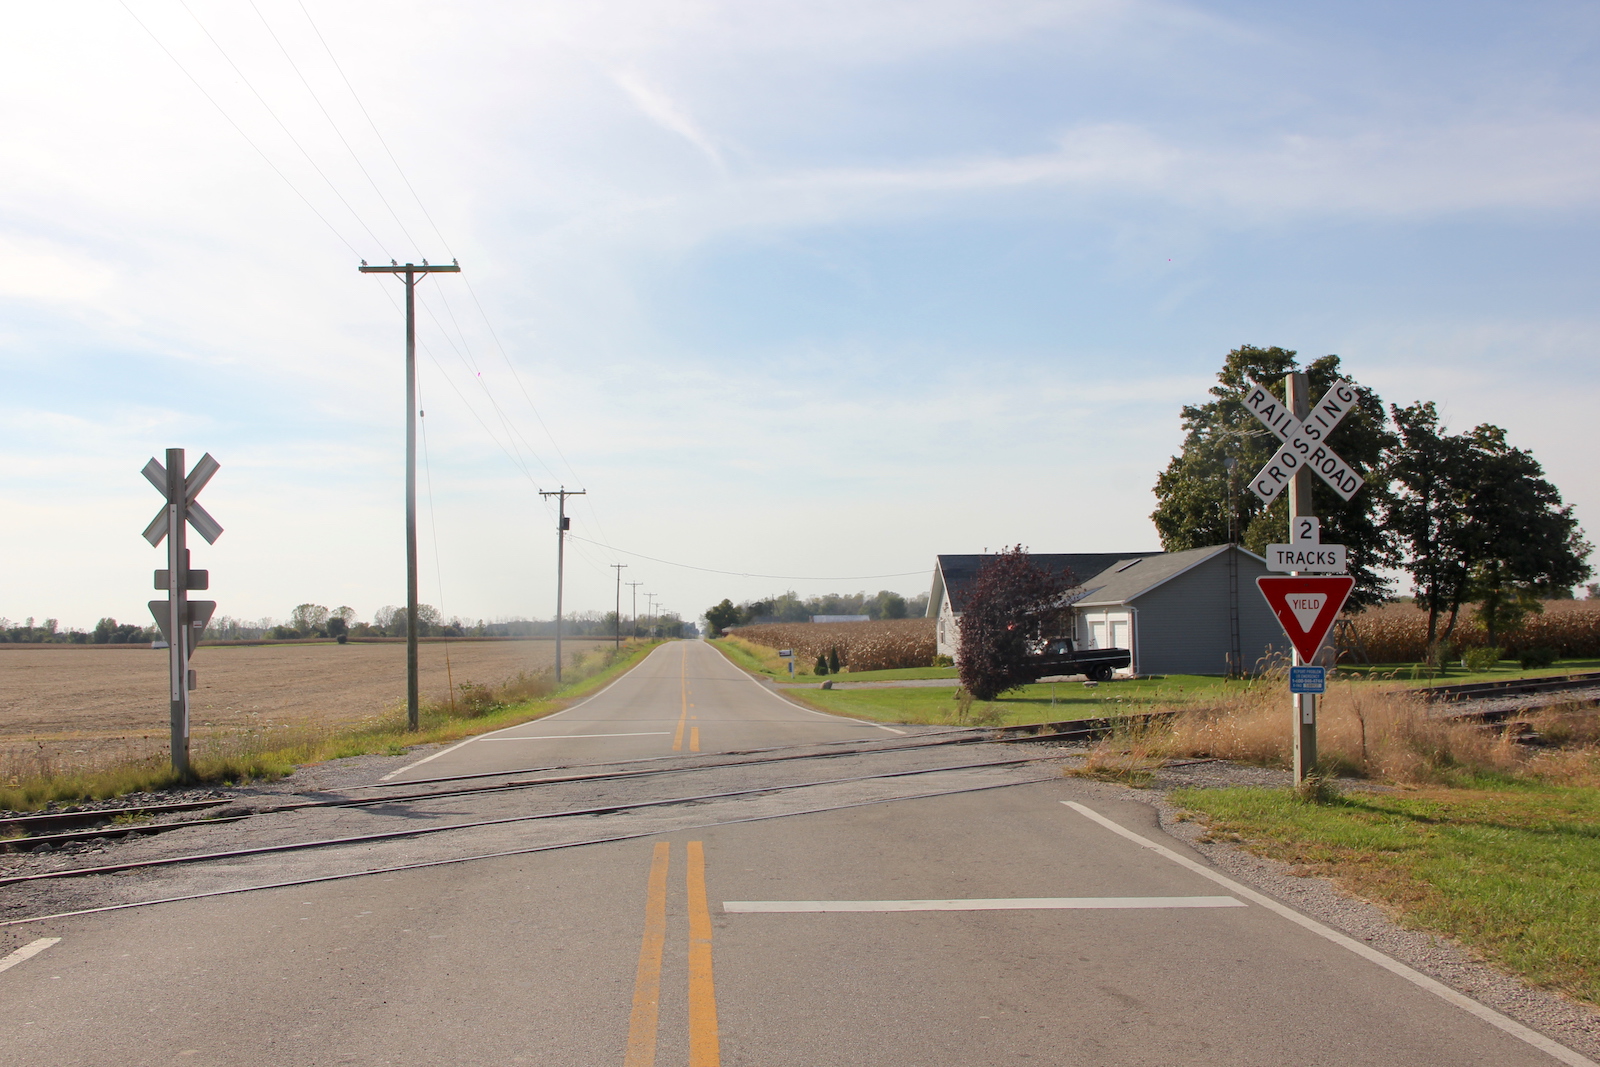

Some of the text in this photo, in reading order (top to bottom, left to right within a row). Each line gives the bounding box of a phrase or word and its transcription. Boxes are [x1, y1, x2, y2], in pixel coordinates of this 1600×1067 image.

[1248, 389, 1357, 493] RAIL ROAD
[1257, 386, 1353, 496] CROSSING
[1300, 522, 1312, 539] 2
[1276, 551, 1336, 565] TRACKS
[1293, 599, 1320, 610] YIELD
